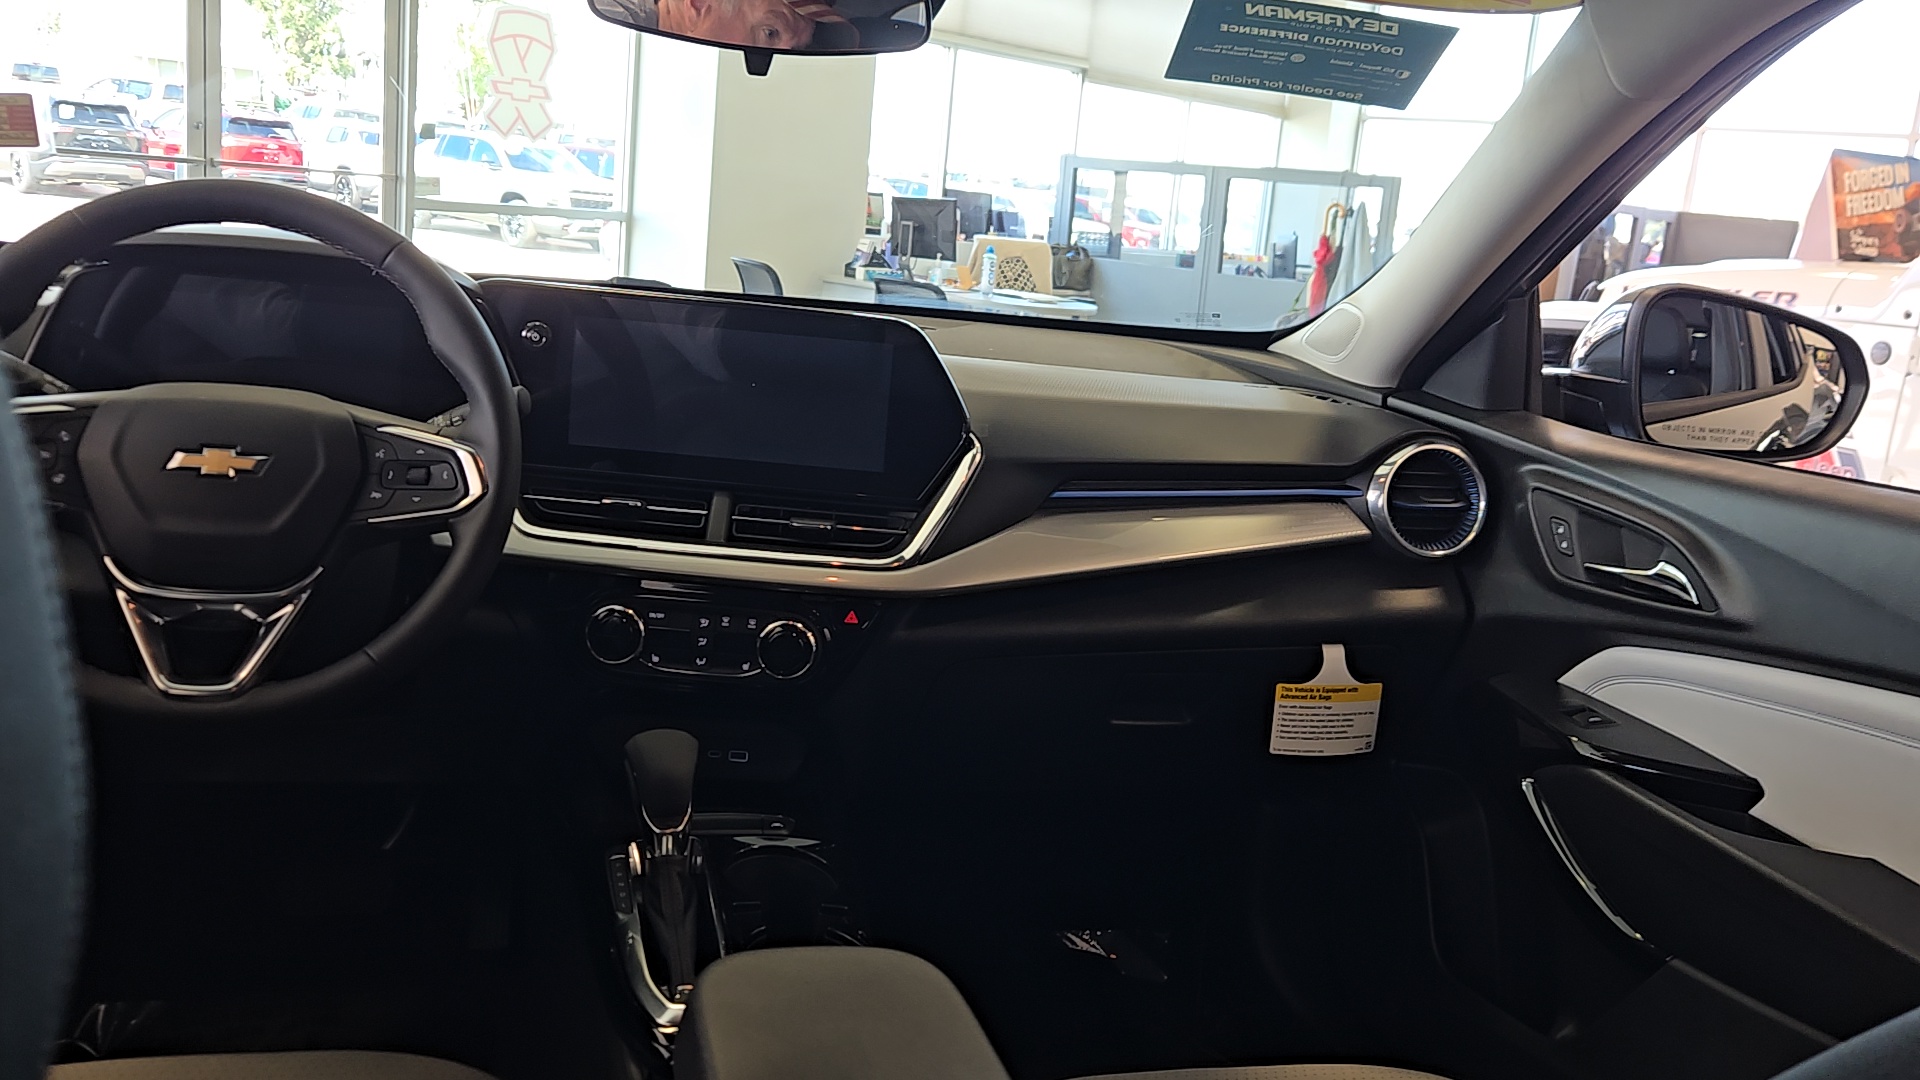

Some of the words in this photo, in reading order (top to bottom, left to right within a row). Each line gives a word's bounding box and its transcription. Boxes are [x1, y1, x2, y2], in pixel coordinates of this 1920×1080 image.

[1843, 163, 1894, 193] FORGED
[1894, 161, 1910, 185] IN
[1845, 185, 1906, 218] FREEDOM
[1661, 424, 1696, 433] OBJECTS
[1708, 427, 1737, 435] MIRROR
[1731, 436, 1757, 445] APPEA
[1321, 686, 1347, 694] Equipped
